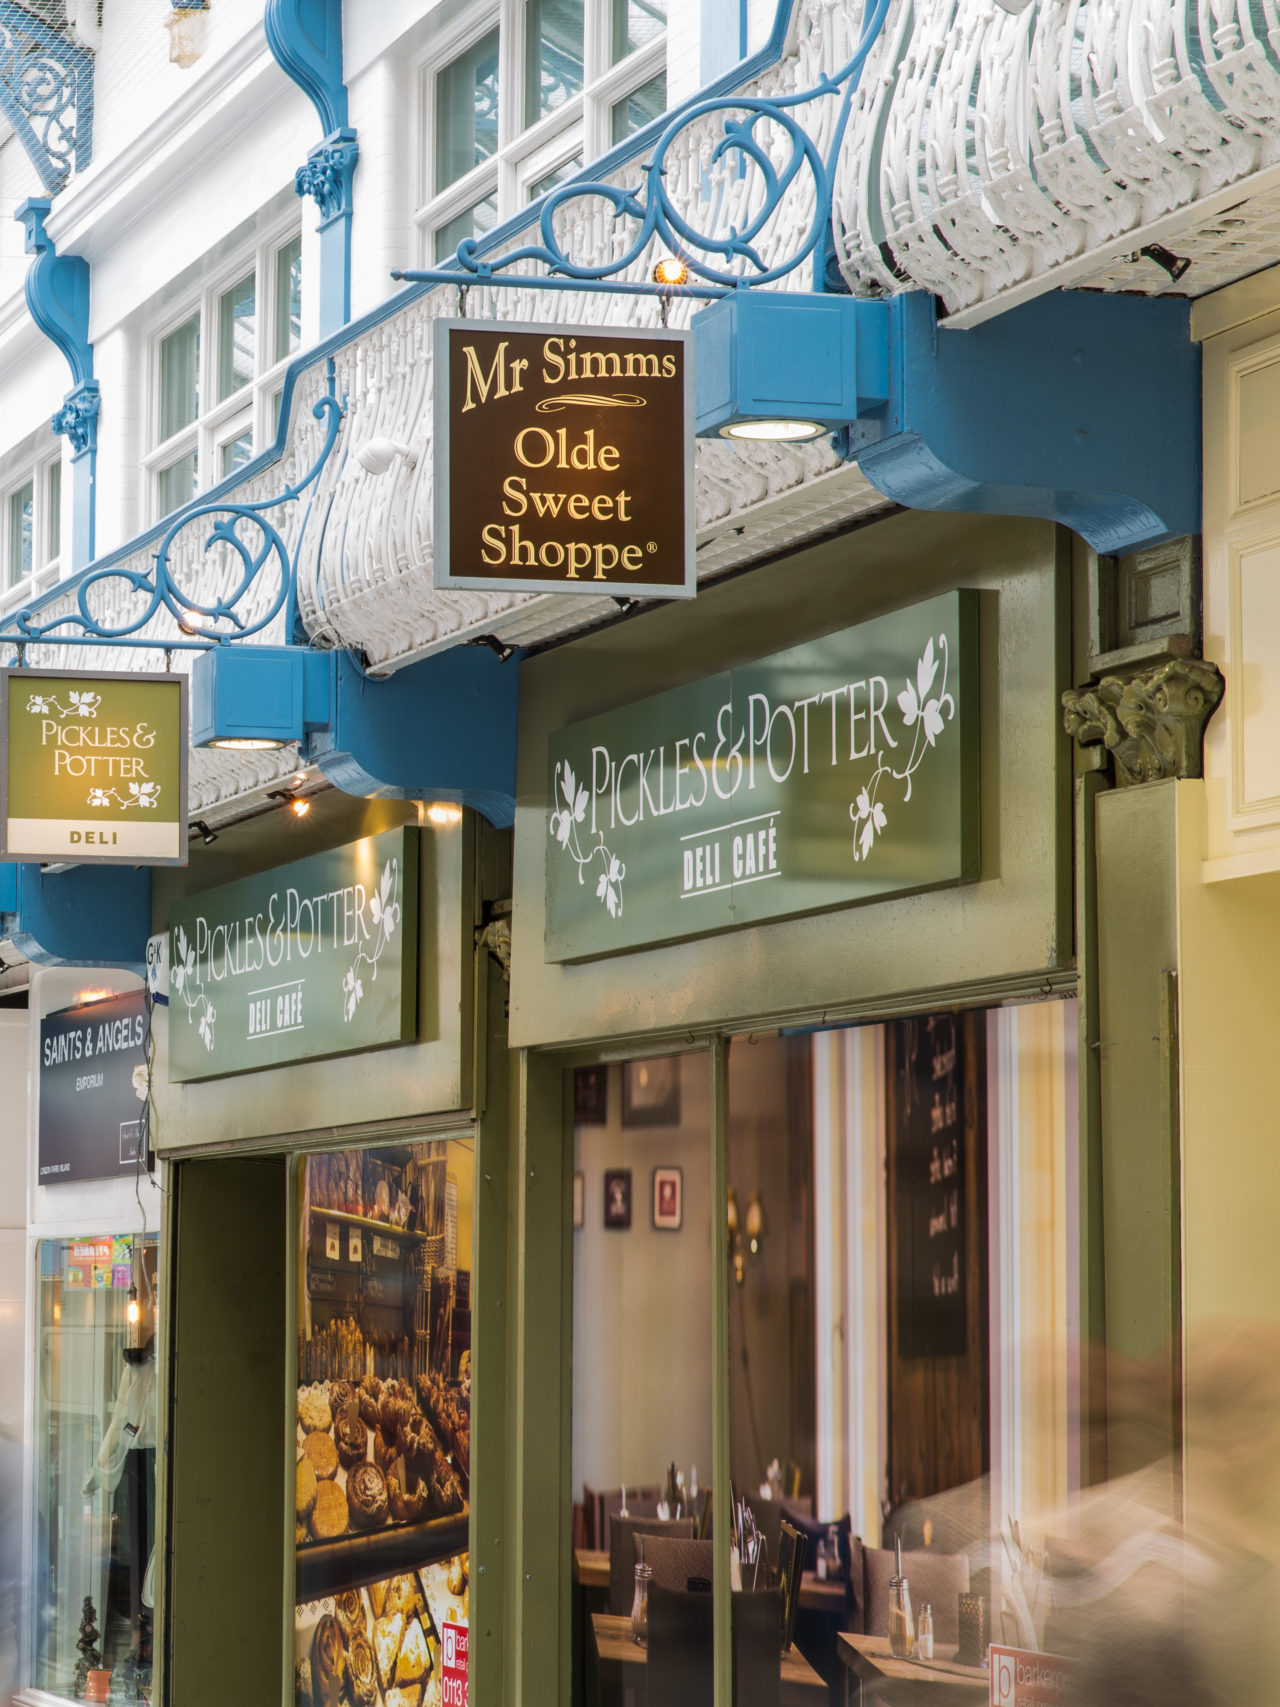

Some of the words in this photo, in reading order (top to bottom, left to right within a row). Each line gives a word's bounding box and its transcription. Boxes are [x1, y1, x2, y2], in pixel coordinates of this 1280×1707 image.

[461, 341, 529, 413] Mr
[542, 337, 676, 385] Simms
[514, 427, 620, 471] Olde
[502, 476, 632, 522] Sweet
[54, 750, 149, 778] POTTER
[70, 831, 117, 845] DELI
[683, 842, 720, 892] DELI
[732, 818, 778, 881] CAFÉ
[248, 998, 271, 1034] DELI
[276, 984, 303, 1029] CAFÉ
[44, 1029, 82, 1066] SAINTS
[85, 1027, 93, 1058] &
[96, 1015, 143, 1056] ANGELS
[75, 1072, 104, 1092] EMPORIUM
[443, 1676, 463, 1706] 0113
